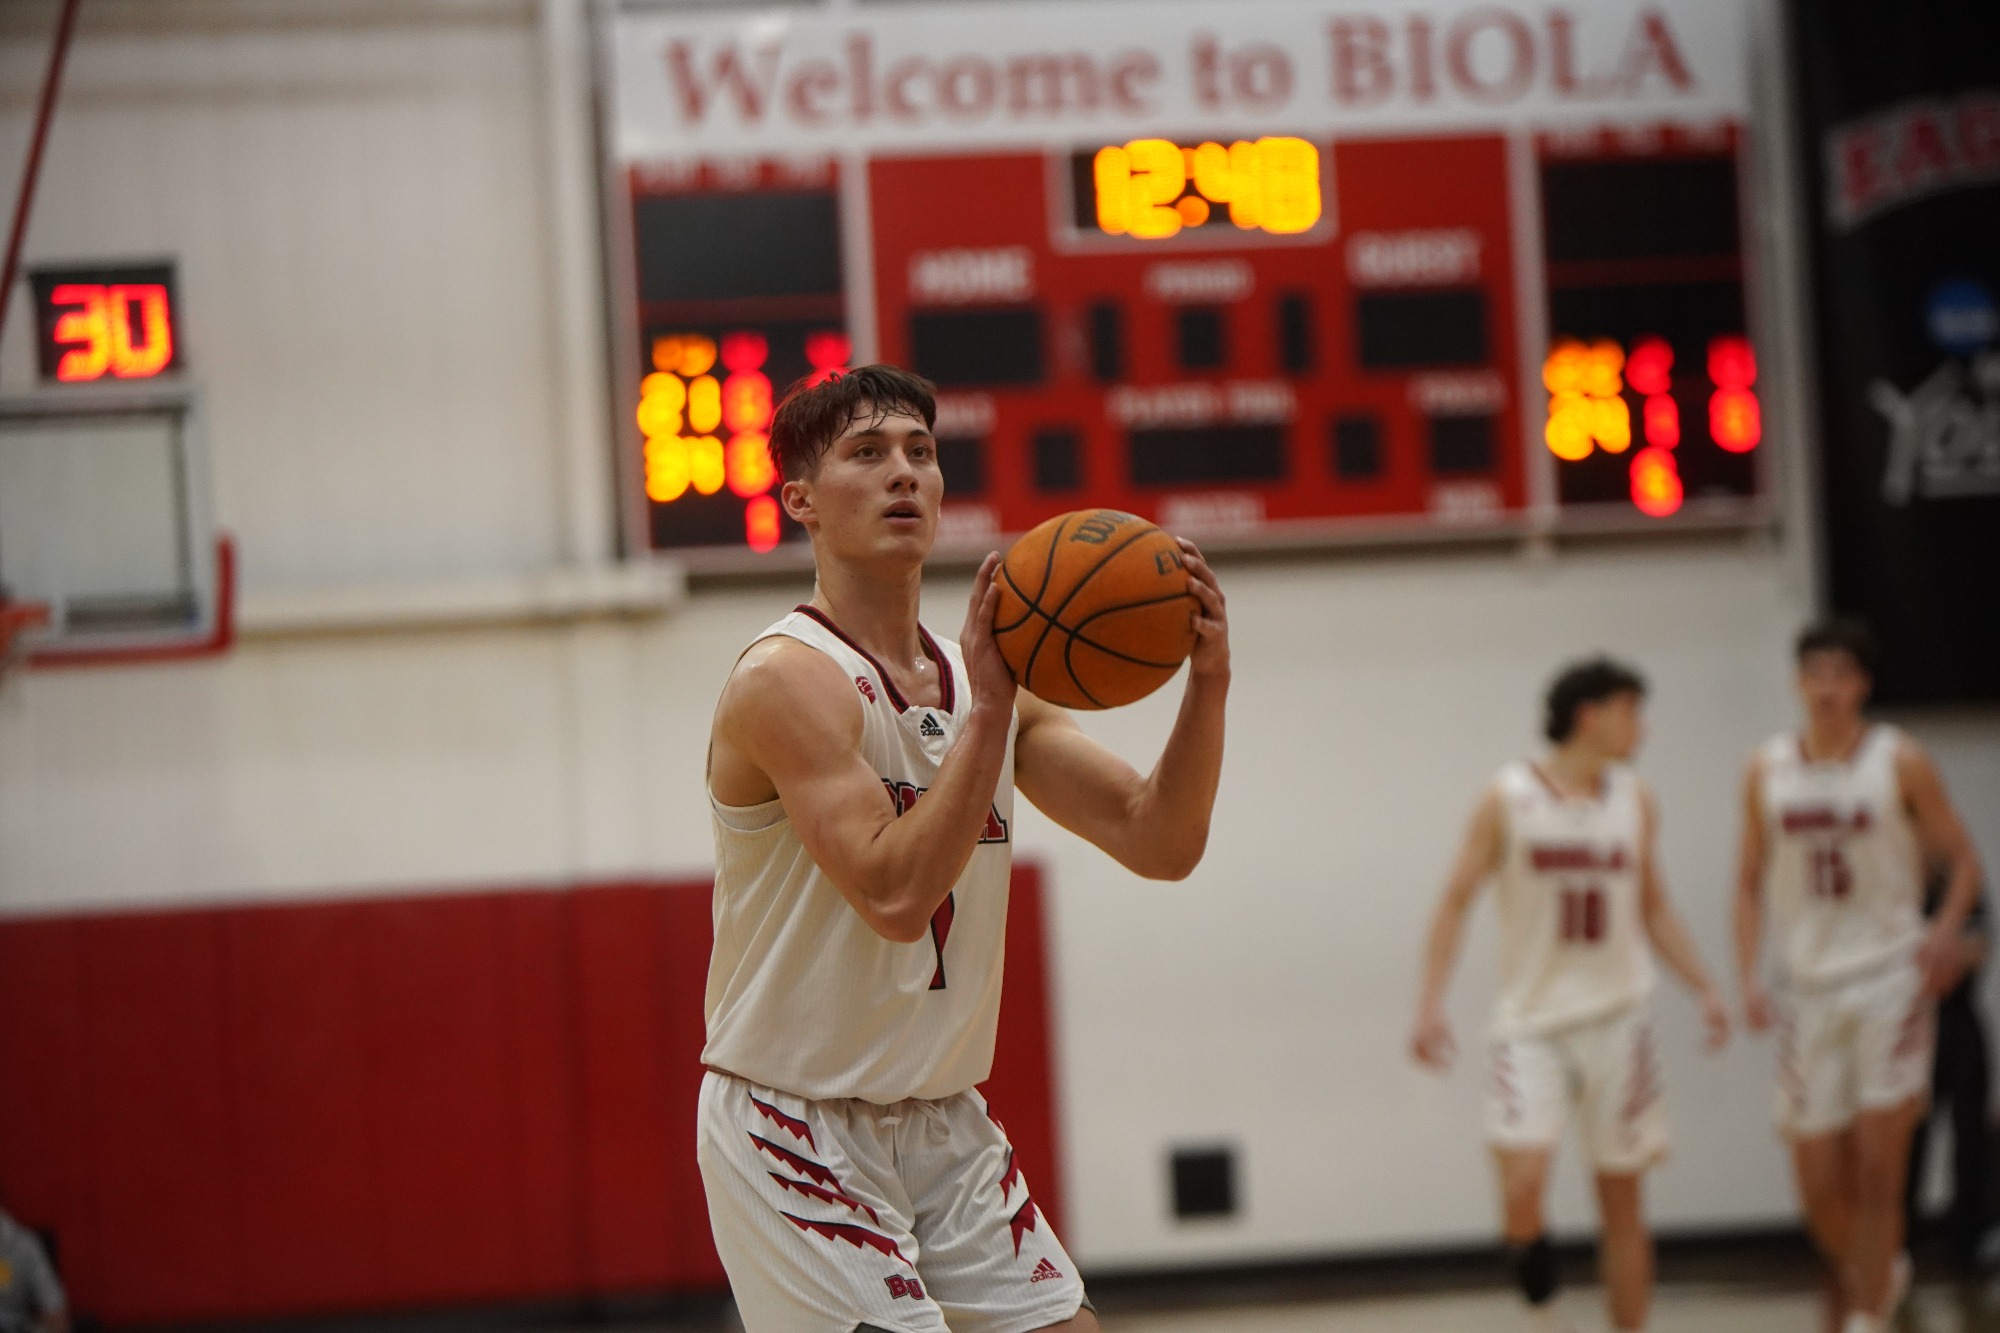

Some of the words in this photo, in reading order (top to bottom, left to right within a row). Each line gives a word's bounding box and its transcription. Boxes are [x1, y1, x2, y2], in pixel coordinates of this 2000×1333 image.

[663, 32, 1163, 125] Welcome
[1188, 32, 1296, 109] to
[1326, 8, 1695, 107] BIOLA
[51, 283, 173, 382] 30
[884, 1273, 926, 1301] BU
